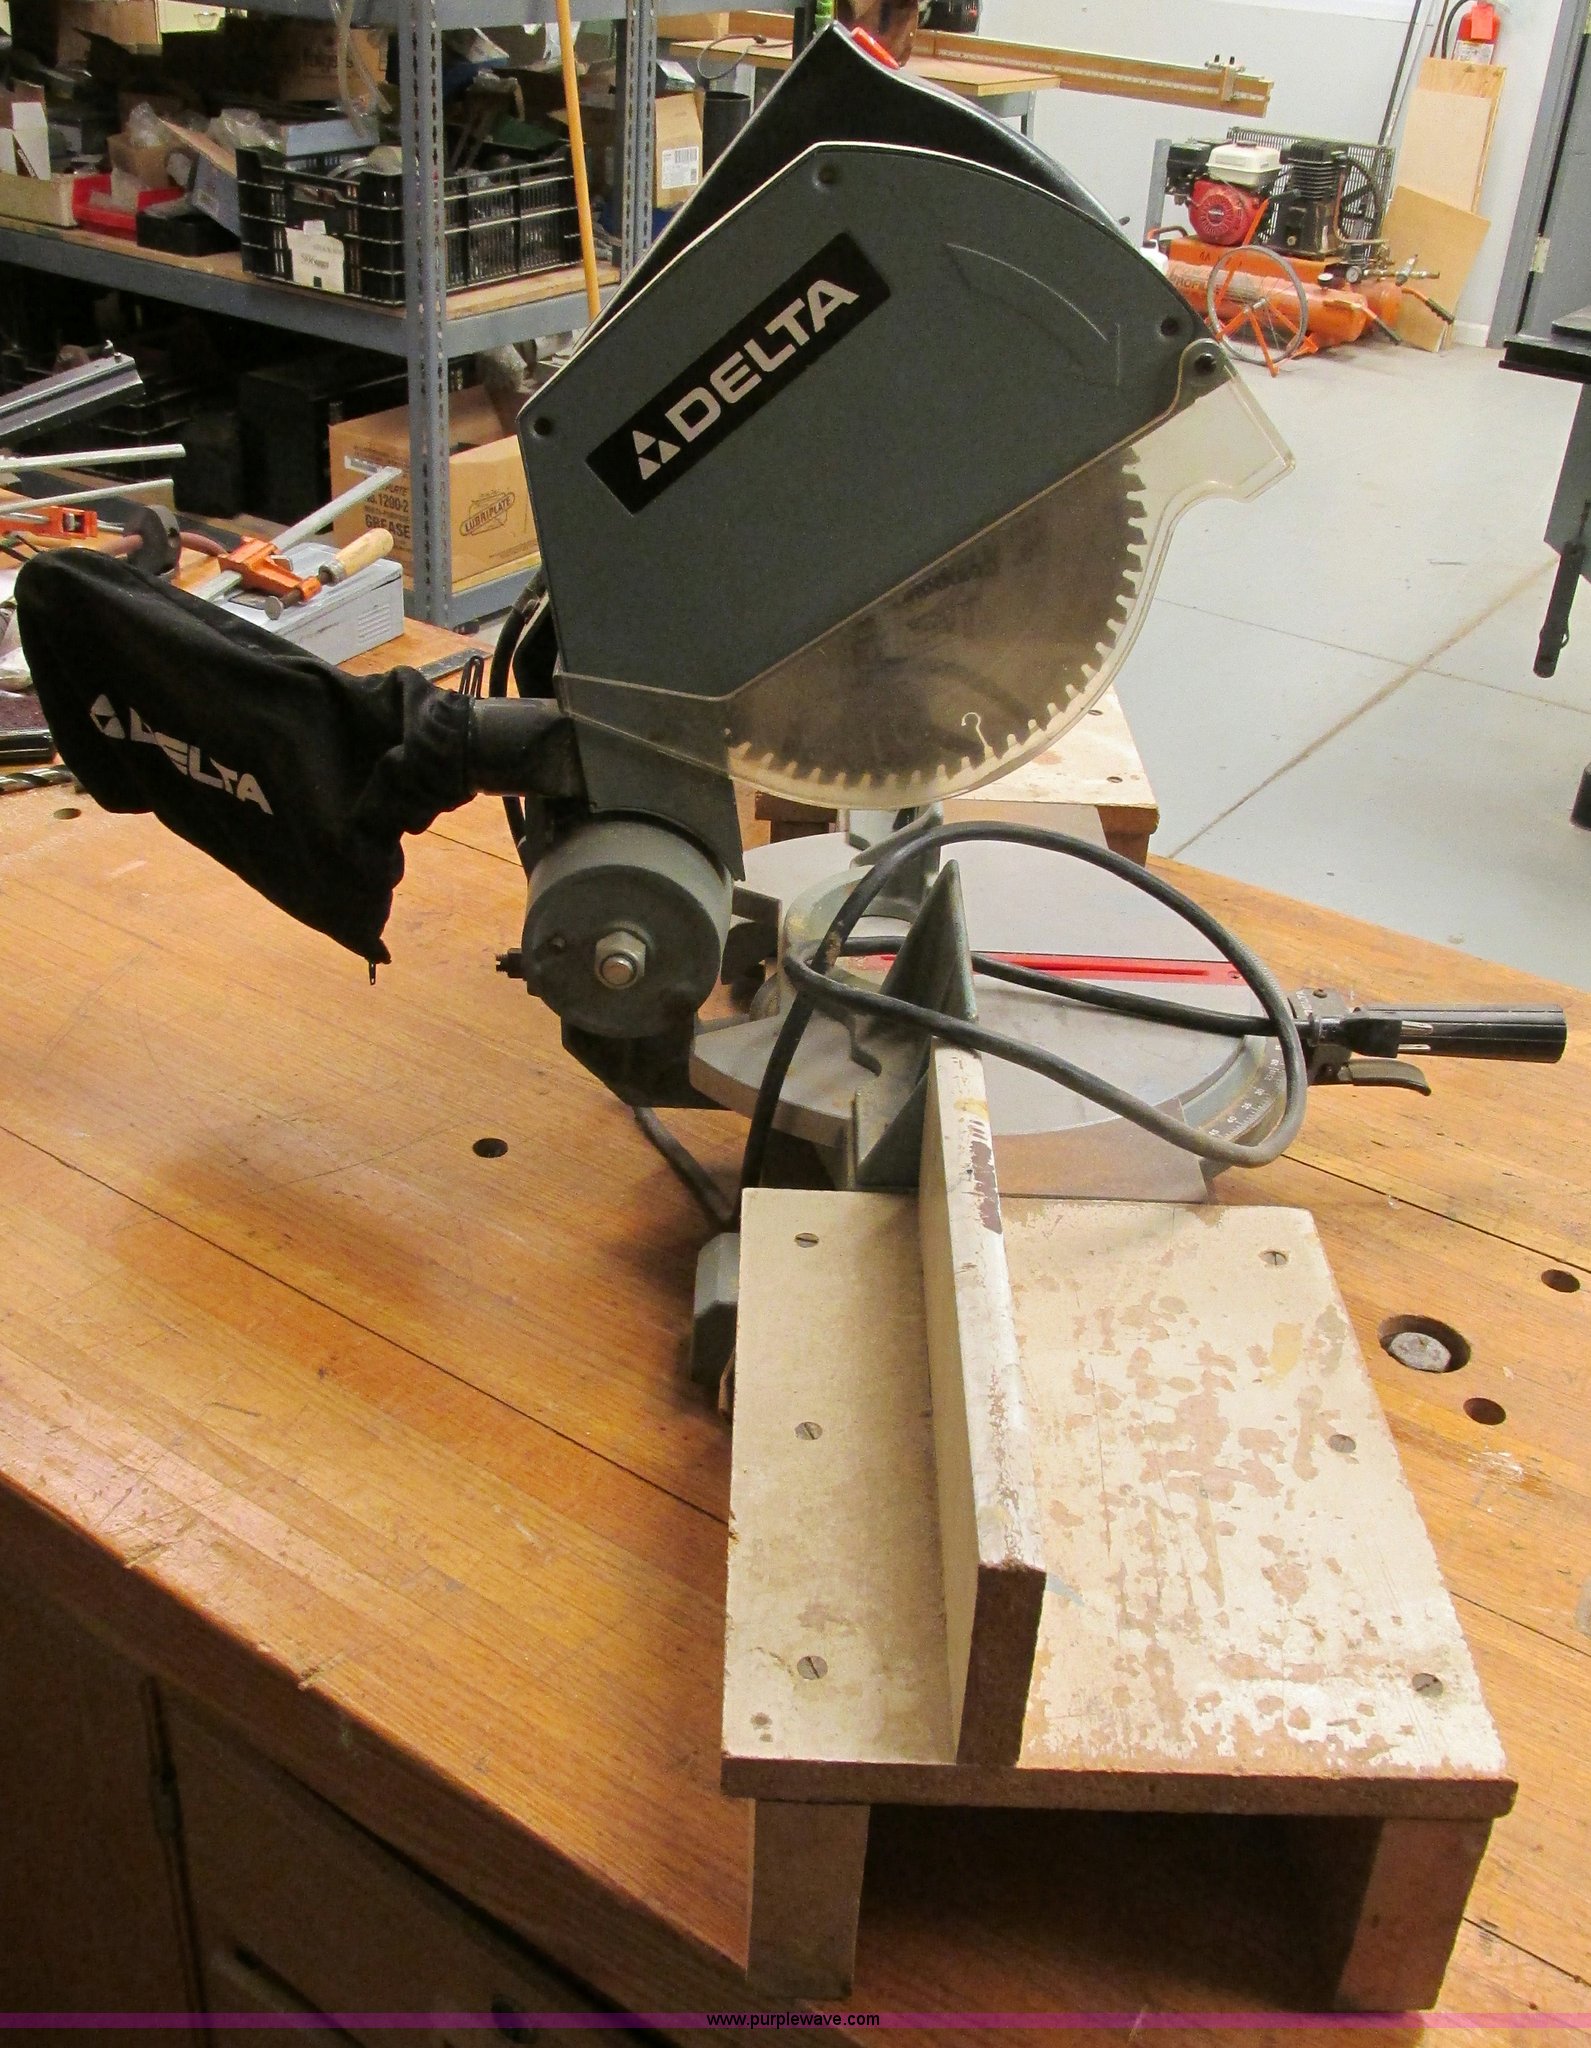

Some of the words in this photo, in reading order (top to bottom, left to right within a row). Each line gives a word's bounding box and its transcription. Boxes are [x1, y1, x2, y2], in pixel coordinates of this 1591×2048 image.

[665, 279, 859, 443] DELTA
[364, 513, 411, 539] GREASE
[464, 496, 511, 532] LUBRIPLATE
